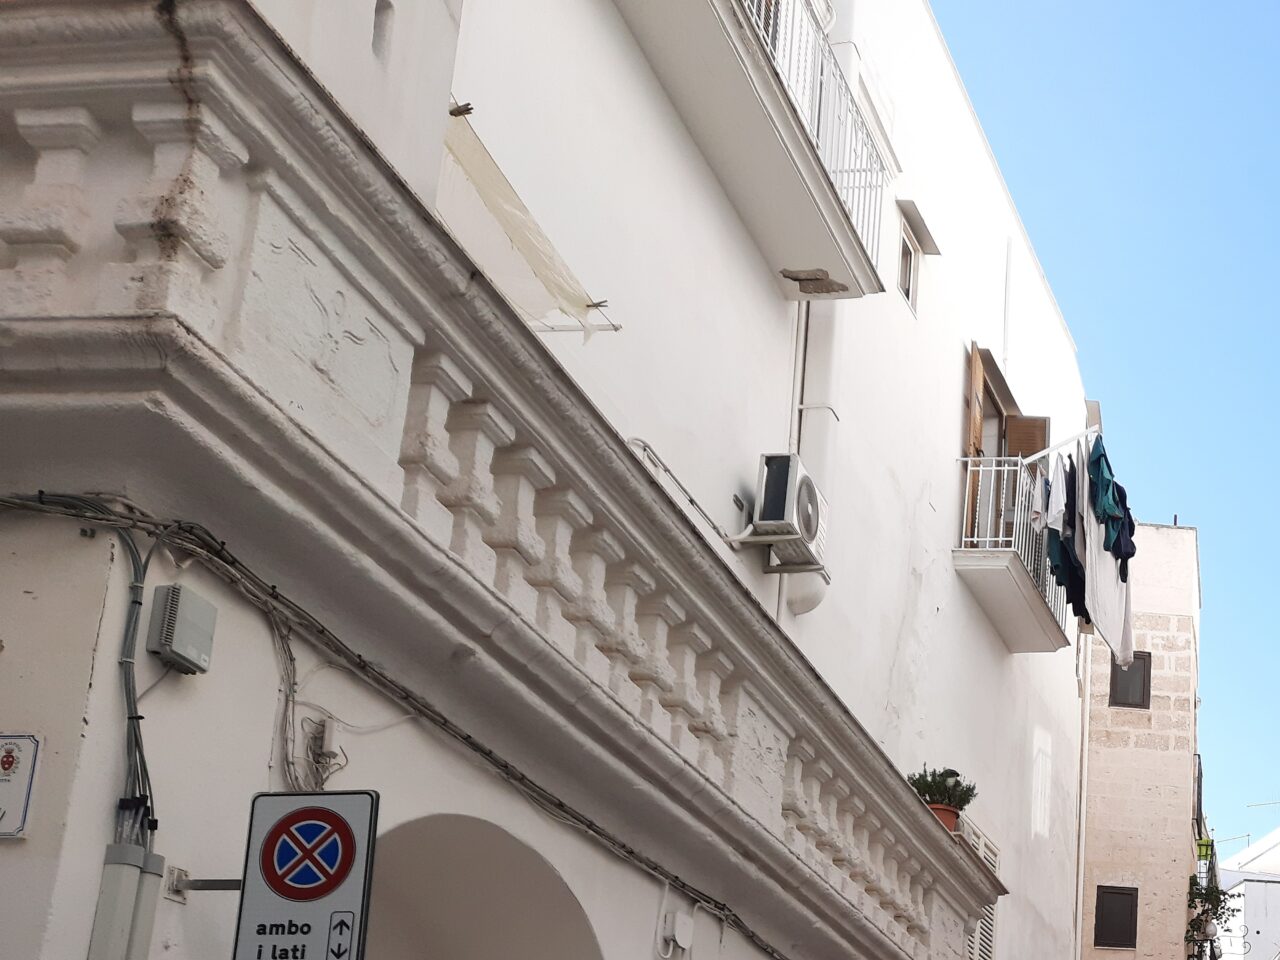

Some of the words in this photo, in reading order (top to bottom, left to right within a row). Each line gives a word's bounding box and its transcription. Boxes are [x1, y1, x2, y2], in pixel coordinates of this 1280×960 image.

[256, 920, 311, 935] ambo
[257, 944, 263, 960] i
[271, 944, 306, 960] lati
